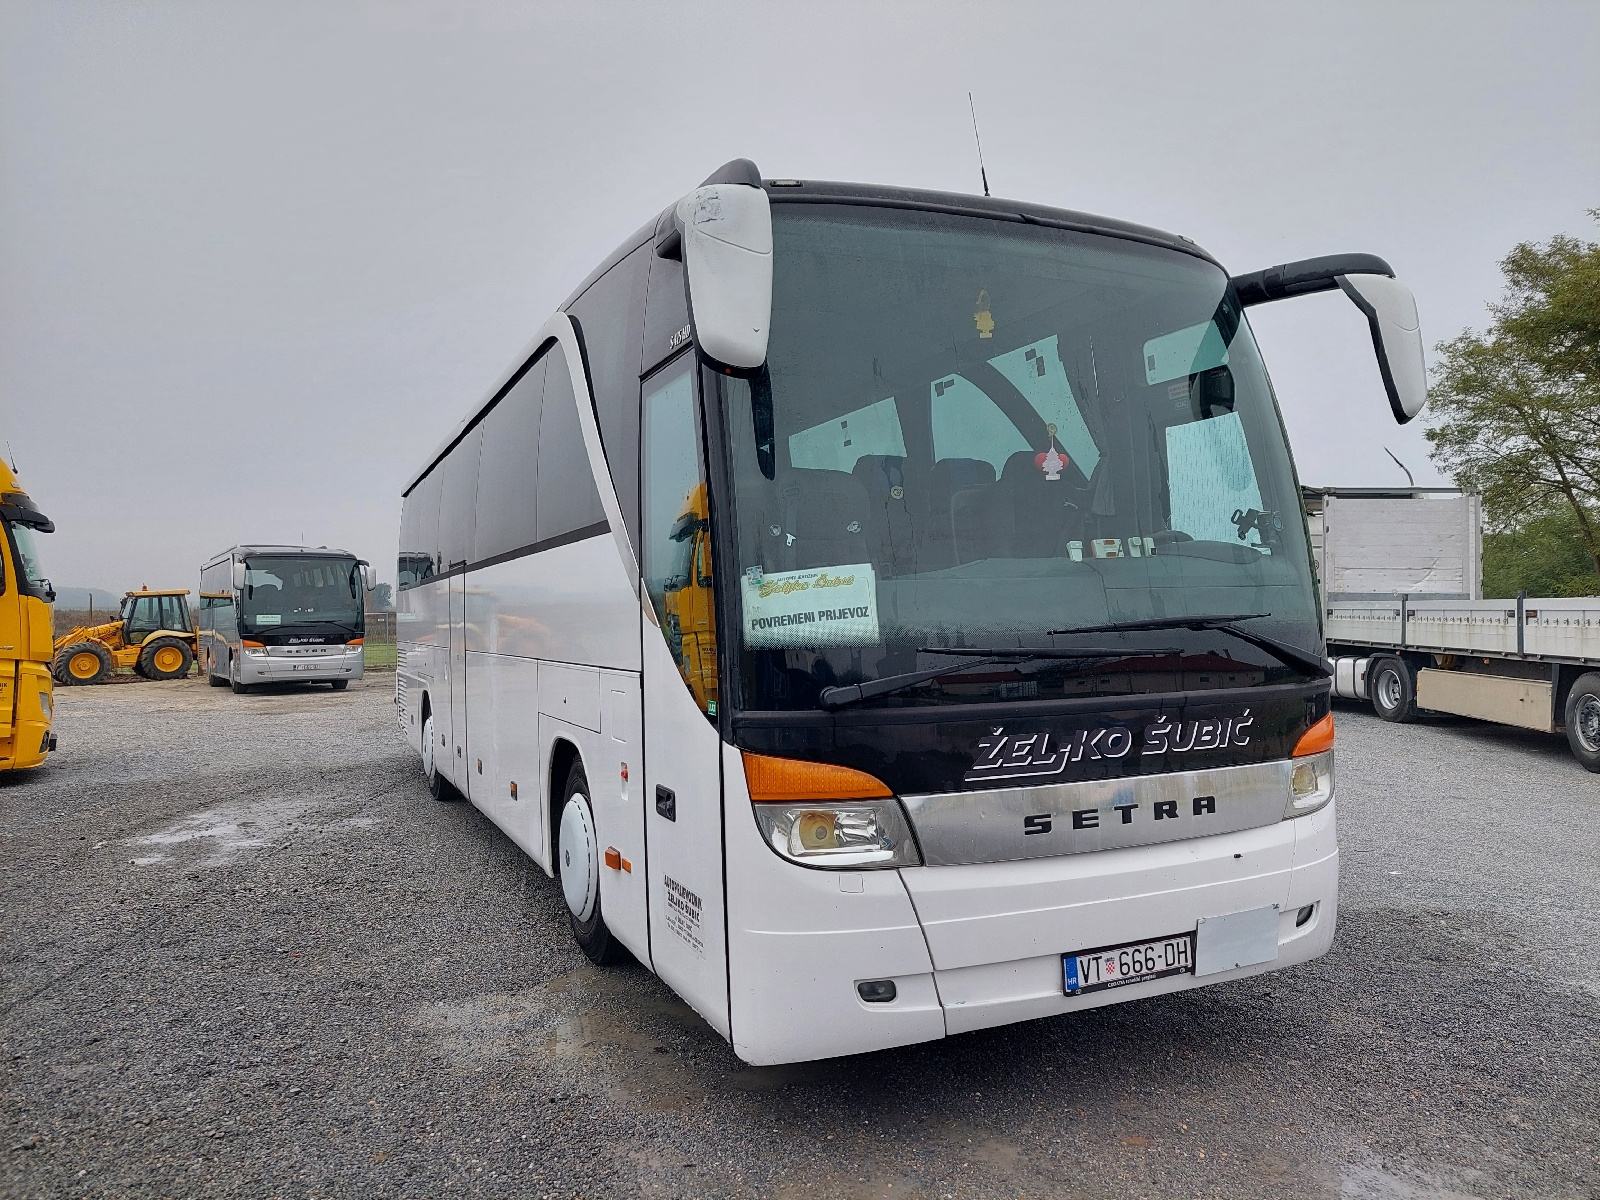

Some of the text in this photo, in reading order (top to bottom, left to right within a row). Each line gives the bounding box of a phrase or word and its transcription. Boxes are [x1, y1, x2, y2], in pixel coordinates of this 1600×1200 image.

[752, 606, 869, 630] POVREMENI PRIJEVOZ
[964, 708, 1254, 781] ŽELJKO ŠUBIĆ
[1023, 795, 1217, 836] SETRA
[1067, 977, 1077, 985] HR
[1080, 940, 1189, 983] VT 666-DH
